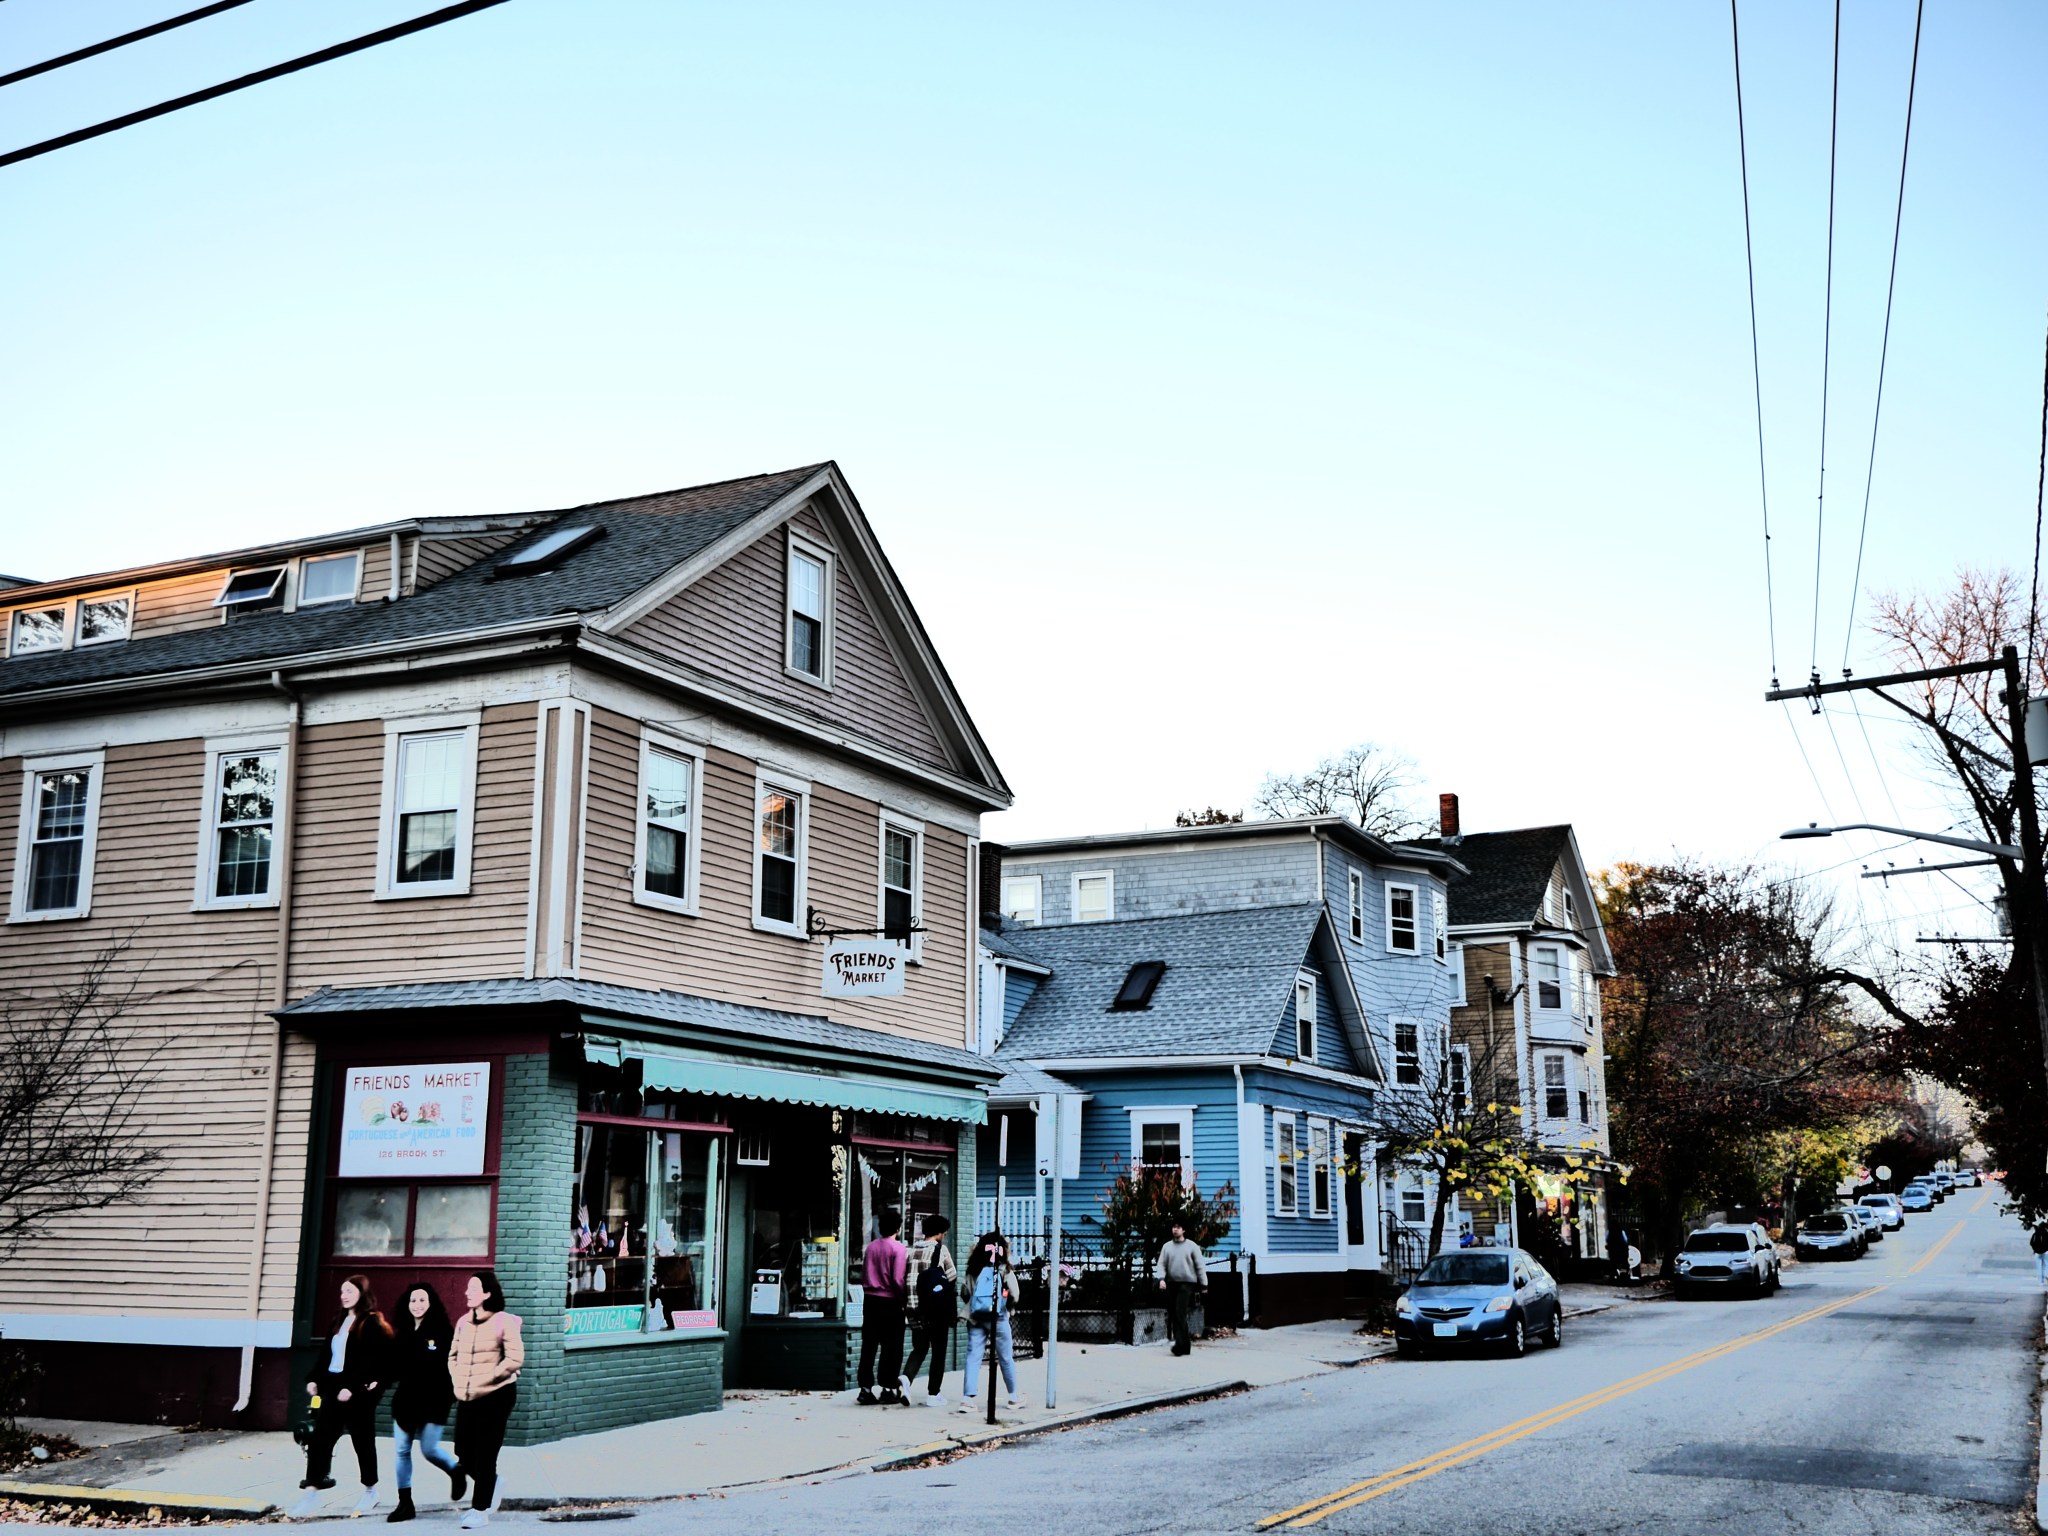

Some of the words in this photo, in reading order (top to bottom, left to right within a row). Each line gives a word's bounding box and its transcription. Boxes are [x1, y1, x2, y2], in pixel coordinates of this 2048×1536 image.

[830, 953, 896, 975] FRIENDS
[841, 971, 886, 986] MARKET
[354, 1075, 410, 1091] FRIENDS
[424, 1072, 481, 1087] MARKET
[348, 1129, 398, 1147] PORTUGUESE
[410, 1127, 451, 1147] AMERICAN
[456, 1127, 476, 1138] FOOD
[379, 1150, 393, 1158] 126
[397, 1150, 428, 1158] BROOK
[572, 1310, 626, 1331] PORTUGAL
